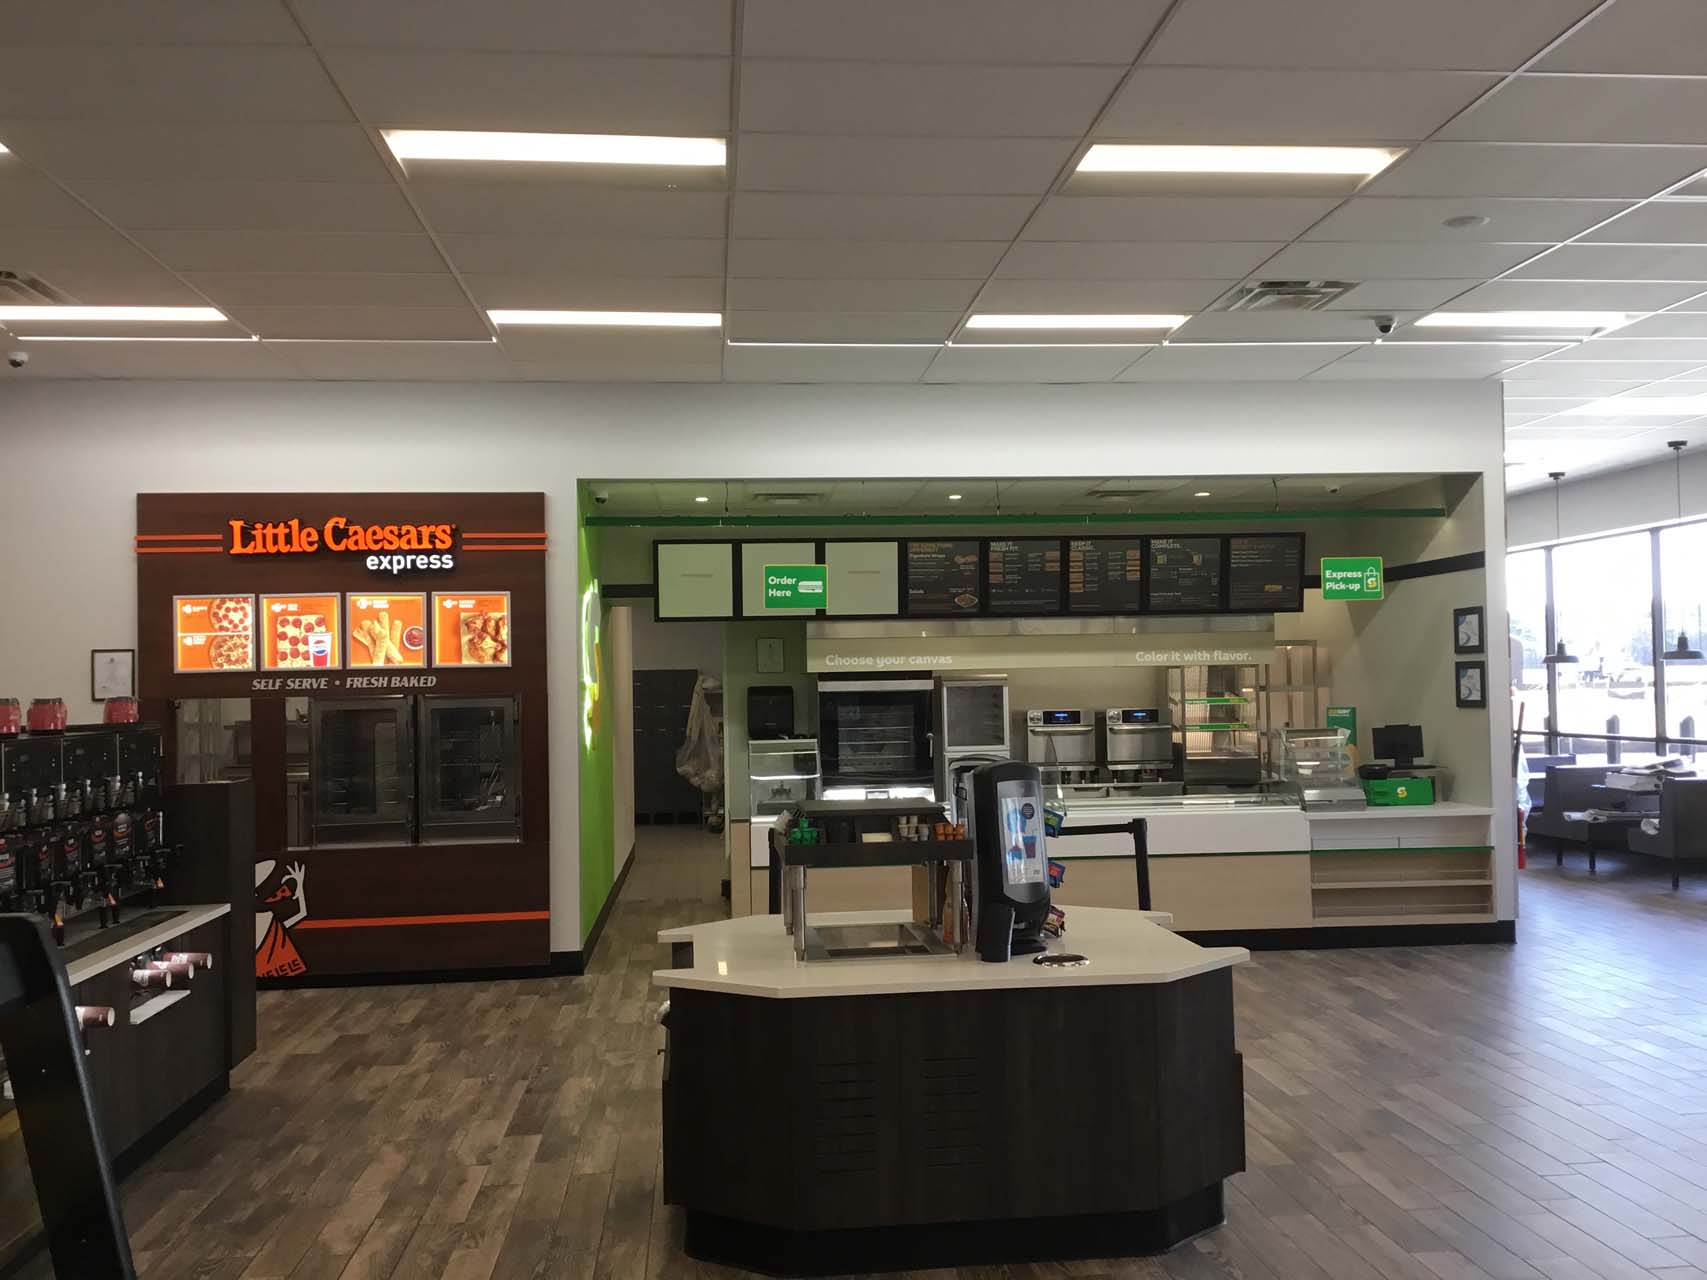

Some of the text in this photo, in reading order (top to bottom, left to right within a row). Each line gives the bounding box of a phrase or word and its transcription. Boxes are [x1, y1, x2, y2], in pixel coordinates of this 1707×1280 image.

[229, 515, 454, 554] Little Caesars
[366, 552, 454, 574] express
[768, 576, 797, 585] Order
[1325, 570, 1362, 580] Express
[768, 588, 792, 597] Here
[1326, 581, 1361, 592] Pick-up
[825, 654, 952, 668] Choose your canvas
[1135, 650, 1252, 663] Color it with flavor.
[252, 675, 437, 691] SELF SERVE FRESH BAKED
